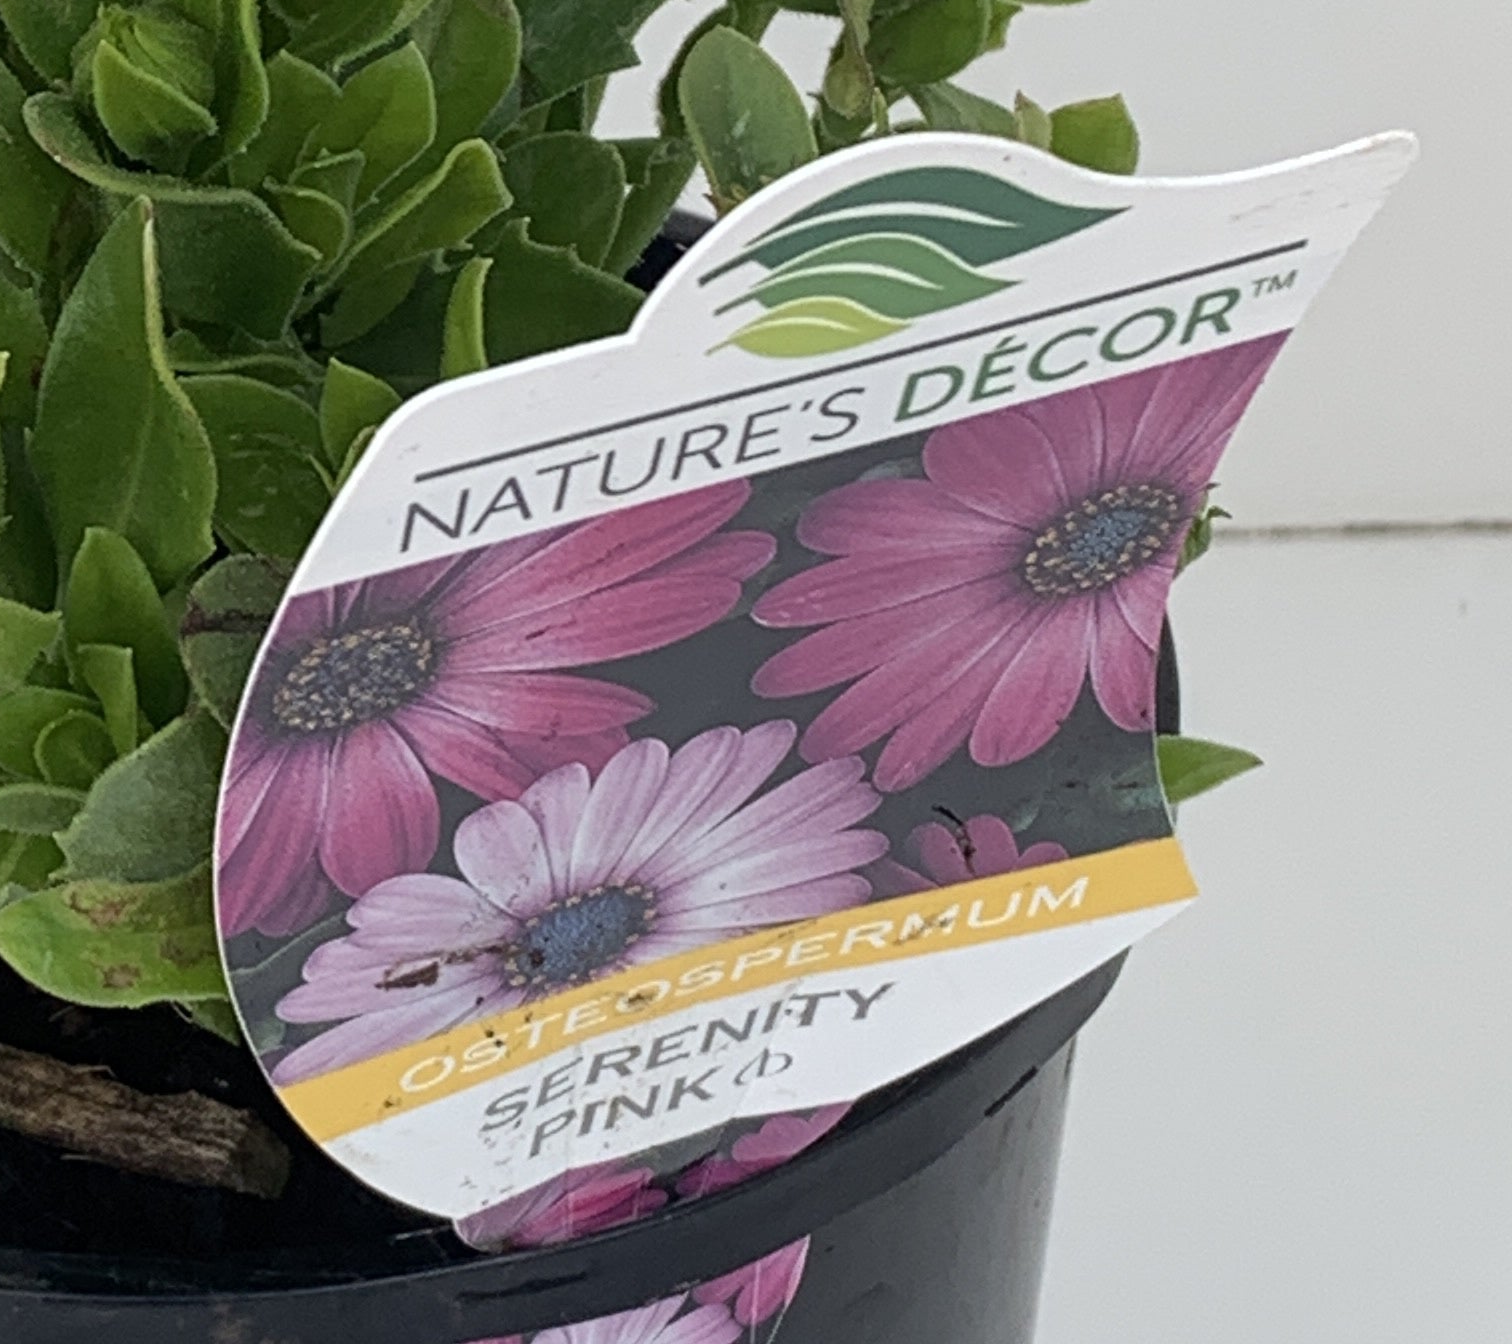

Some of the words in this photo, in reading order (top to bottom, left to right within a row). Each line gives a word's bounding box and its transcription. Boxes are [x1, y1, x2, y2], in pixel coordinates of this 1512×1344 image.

[398, 386, 867, 553] NATURE'S
[399, 877, 1090, 1094] OSTEOSPERMUM
[481, 981, 898, 1133] SERENITY
[527, 1075, 718, 1158] PINK
